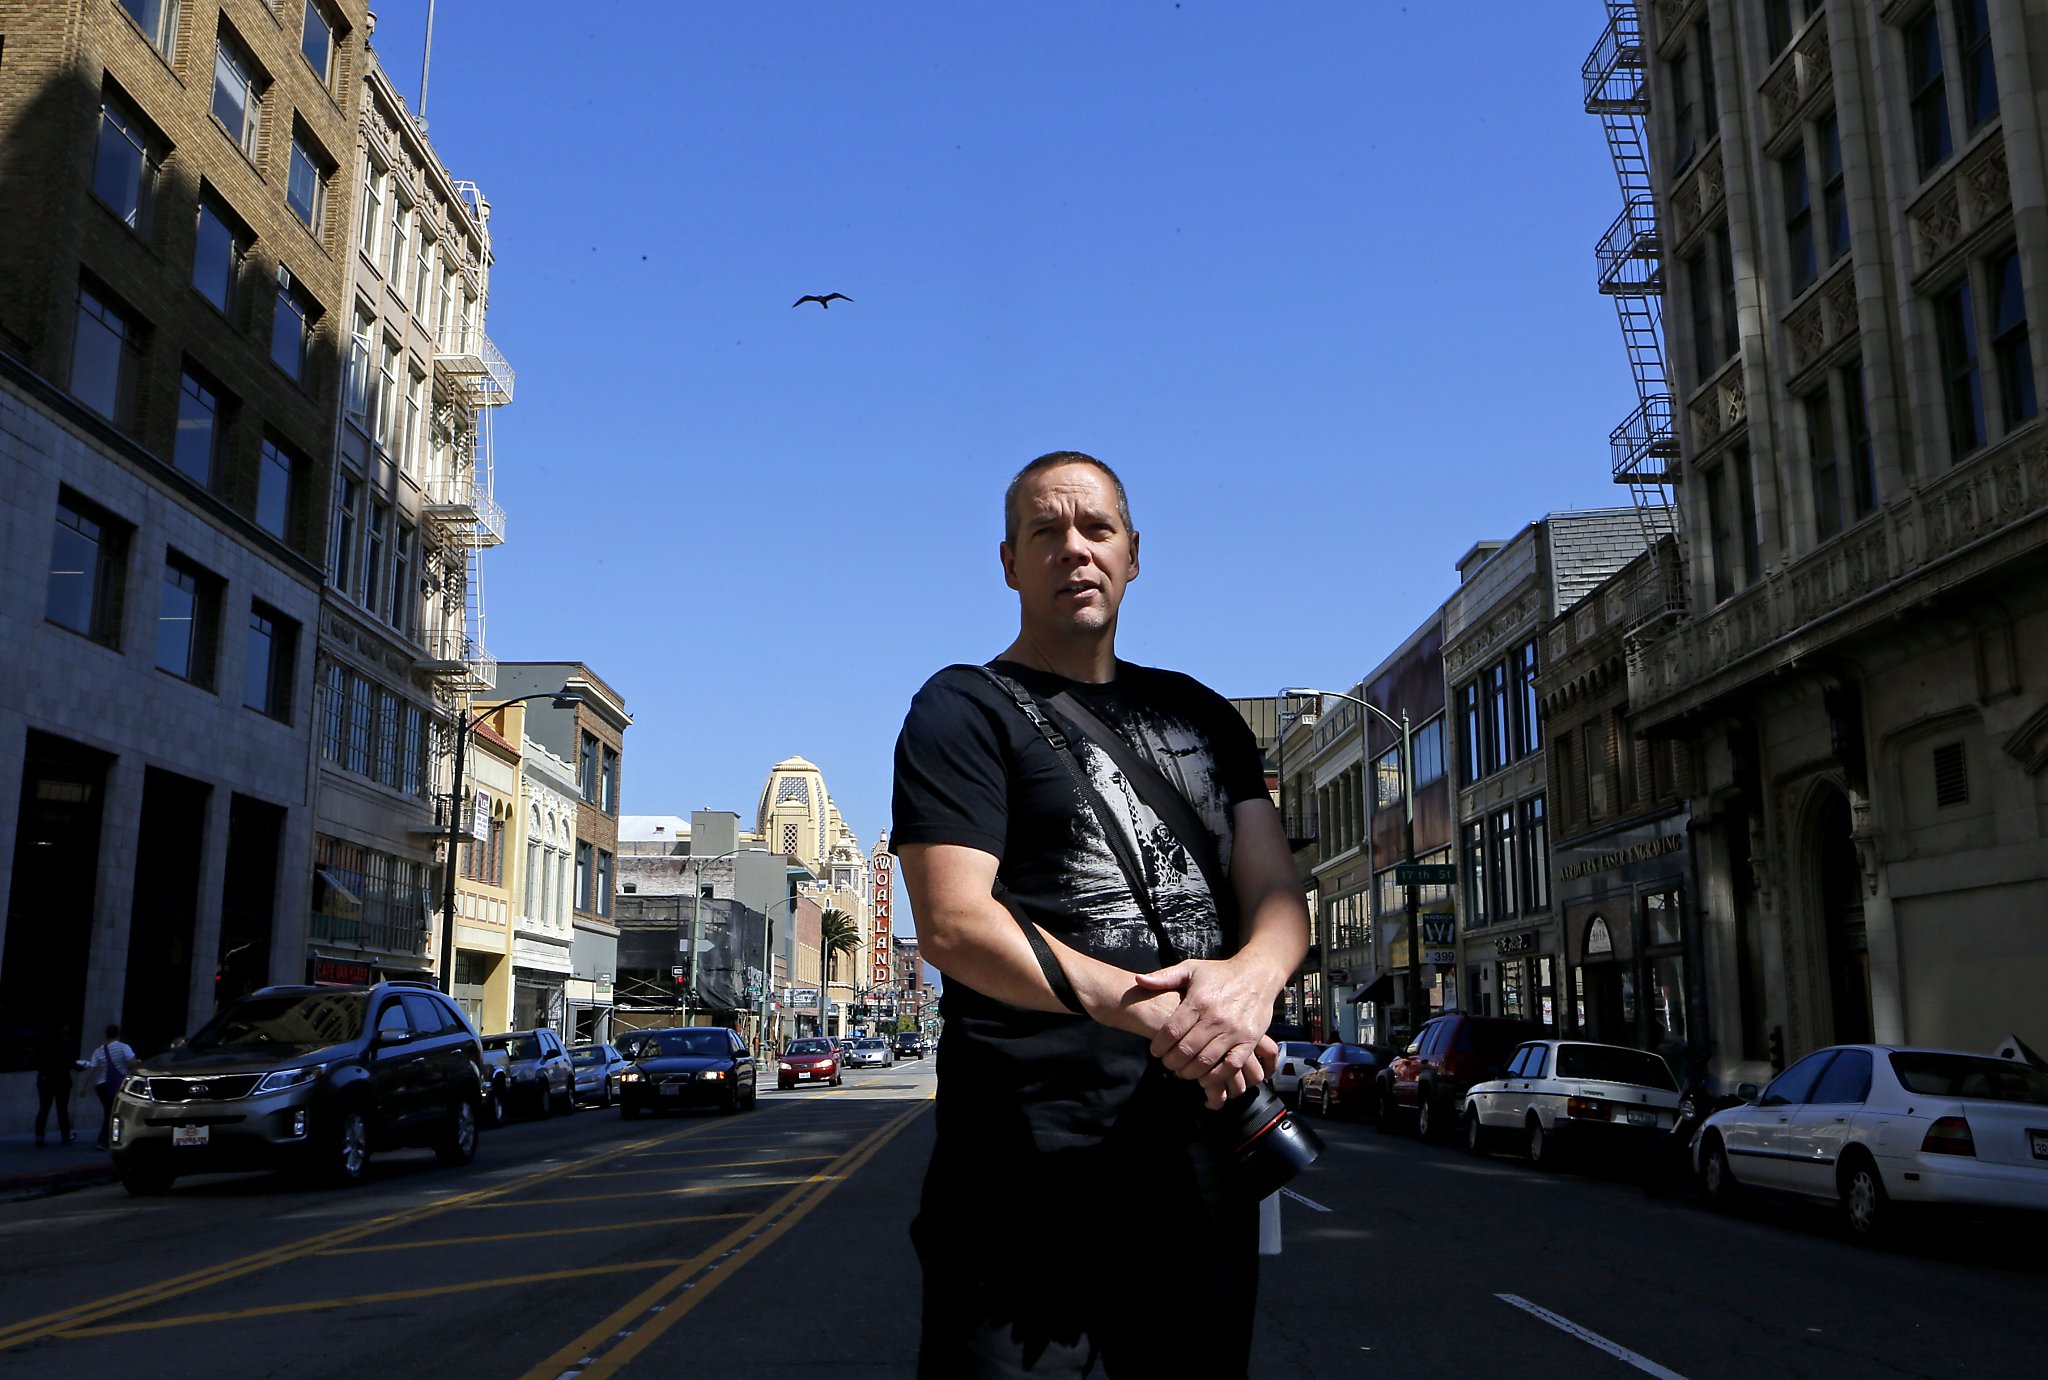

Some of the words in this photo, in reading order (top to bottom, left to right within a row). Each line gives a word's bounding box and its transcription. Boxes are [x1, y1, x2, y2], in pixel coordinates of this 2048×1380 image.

[1560, 858, 1598, 881] AARDVARK
[1600, 850, 1626, 871] LASER
[1628, 834, 1681, 860] ENGRAVING
[1439, 869, 1451, 879] St
[875, 874, 888, 980] OAKLAND
[1434, 951, 1455, 962] 399
